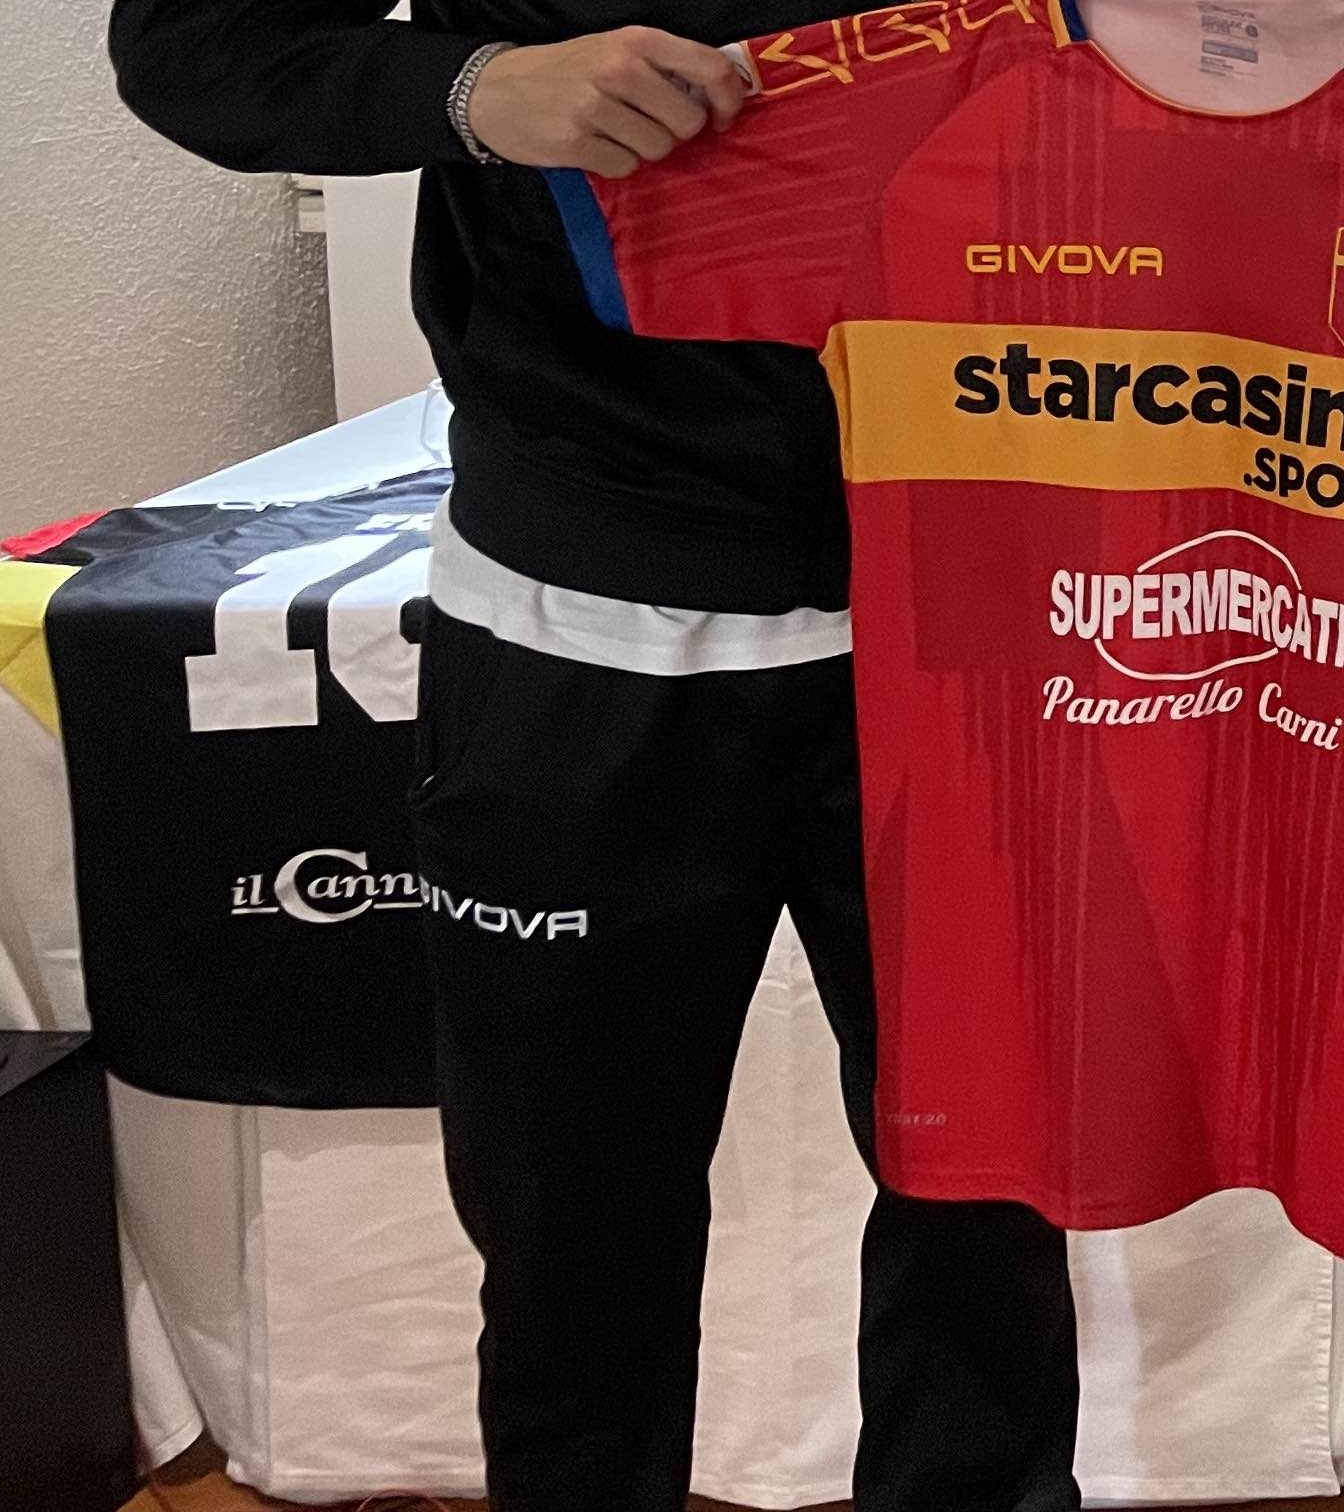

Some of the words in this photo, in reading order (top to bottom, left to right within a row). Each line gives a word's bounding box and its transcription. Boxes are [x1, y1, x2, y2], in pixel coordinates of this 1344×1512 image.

[966, 244, 1163, 277] GIVOVA
[1042, 675, 1243, 726] Panarello
[1258, 682, 1342, 751] Carni
[231, 874, 264, 906] il
[274, 849, 421, 923] Cann
